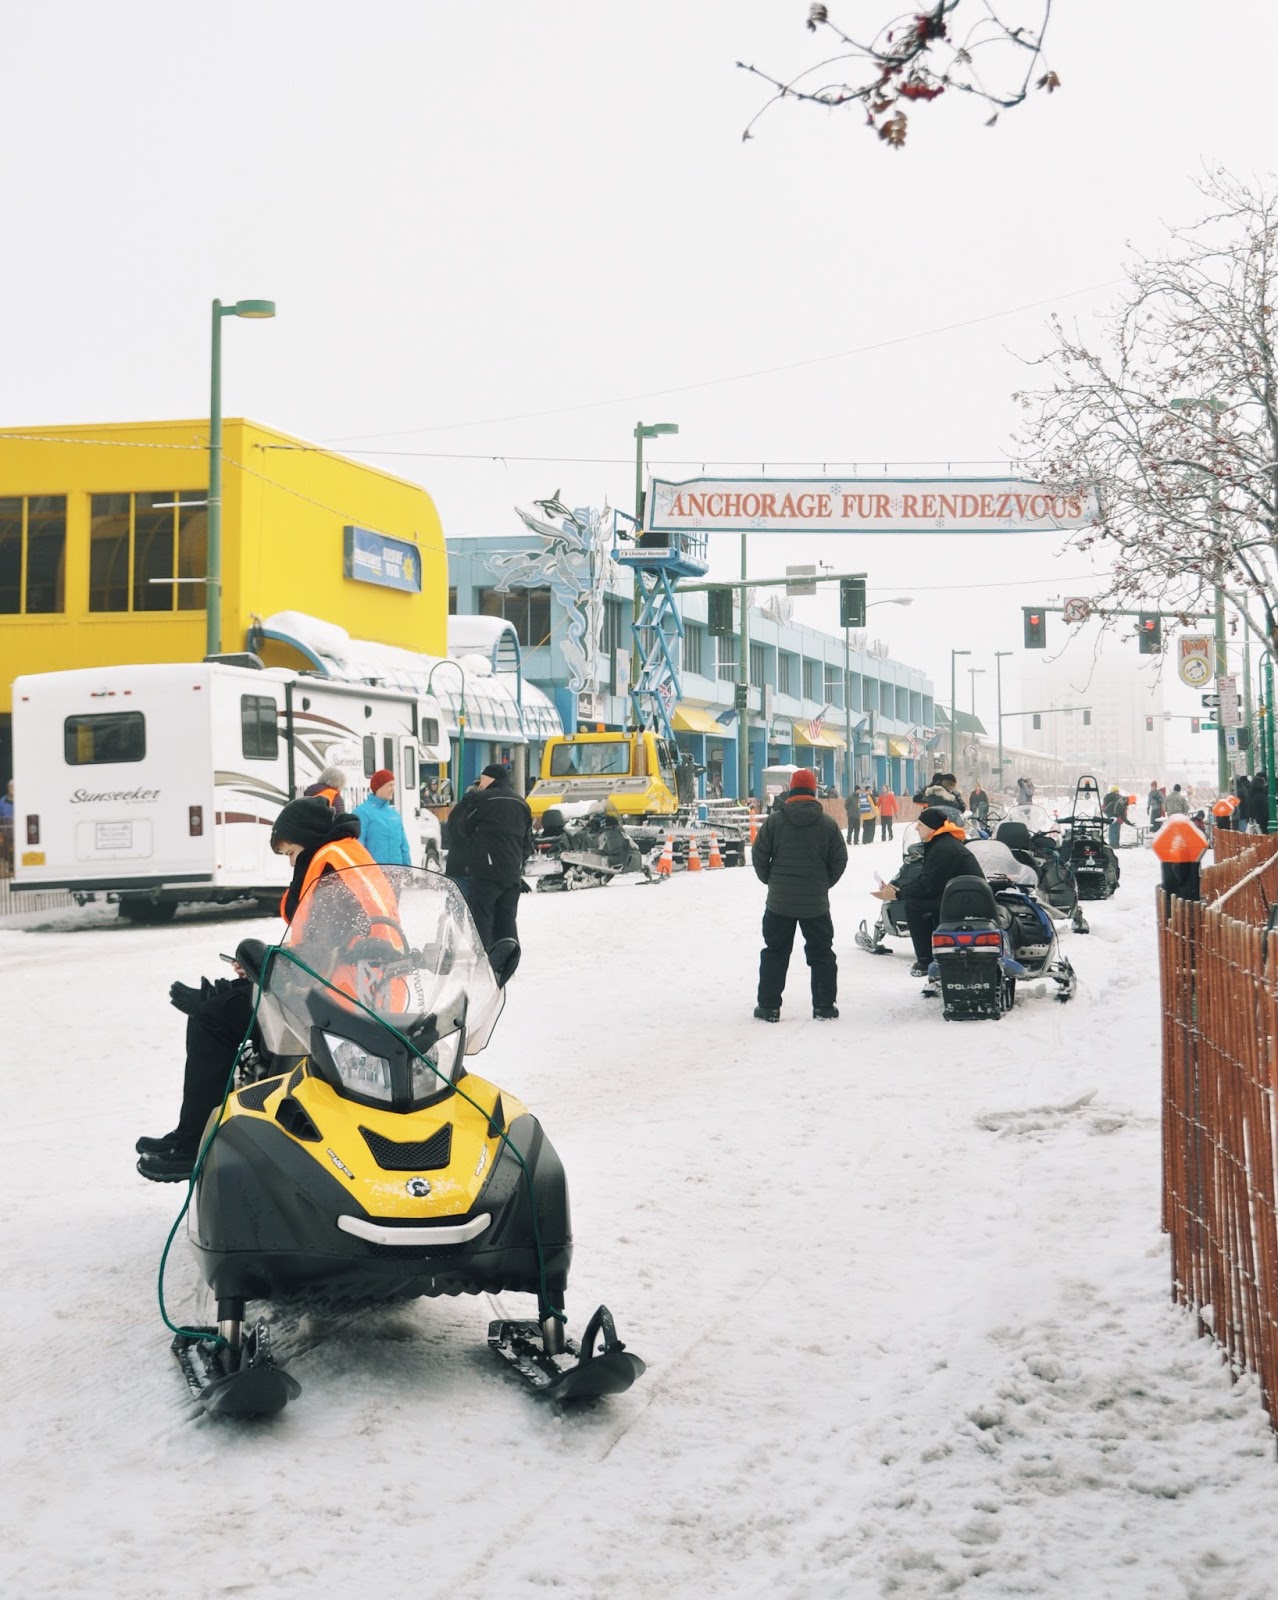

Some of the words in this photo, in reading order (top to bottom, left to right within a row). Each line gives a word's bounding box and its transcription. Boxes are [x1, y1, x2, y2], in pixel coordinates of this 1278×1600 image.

[668, 492, 833, 519] ANCHORAGE
[841, 494, 893, 519] FUR
[901, 493, 1083, 519] RENDEZVOUS
[70, 786, 161, 804] Sunseeker
[946, 982, 991, 990] POLARIS
